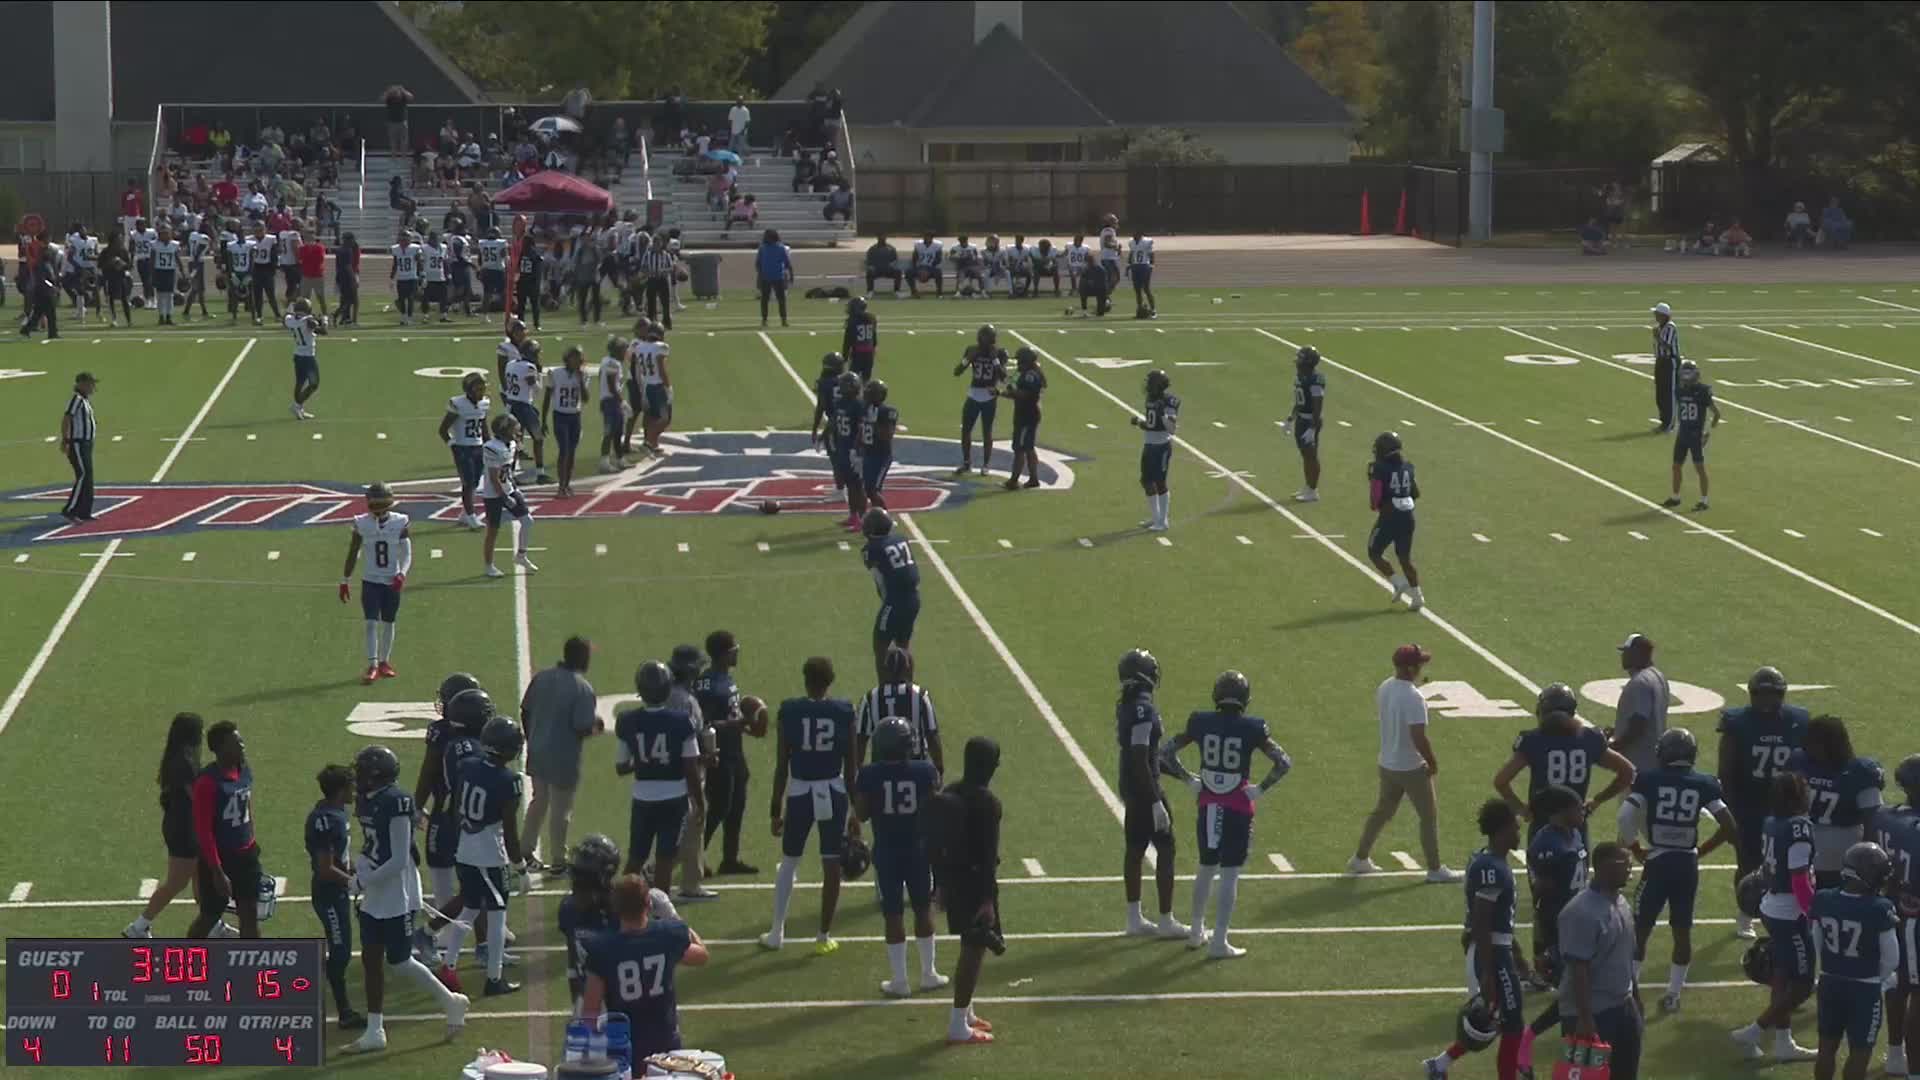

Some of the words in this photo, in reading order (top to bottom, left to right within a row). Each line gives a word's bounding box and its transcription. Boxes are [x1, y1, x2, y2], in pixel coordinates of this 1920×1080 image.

[1389, 470, 1412, 498] 44
[376, 541, 388, 568] 8
[884, 541, 915, 568] 27
[636, 732, 671, 764] 14
[801, 717, 836, 751] 12
[1203, 734, 1242, 769] 86
[1547, 750, 1588, 785] 88
[459, 781, 488, 821] 10
[883, 780, 918, 815] 13
[1655, 787, 1700, 821] 29
[1824, 916, 1862, 958] 37
[616, 953, 667, 1001] 87
